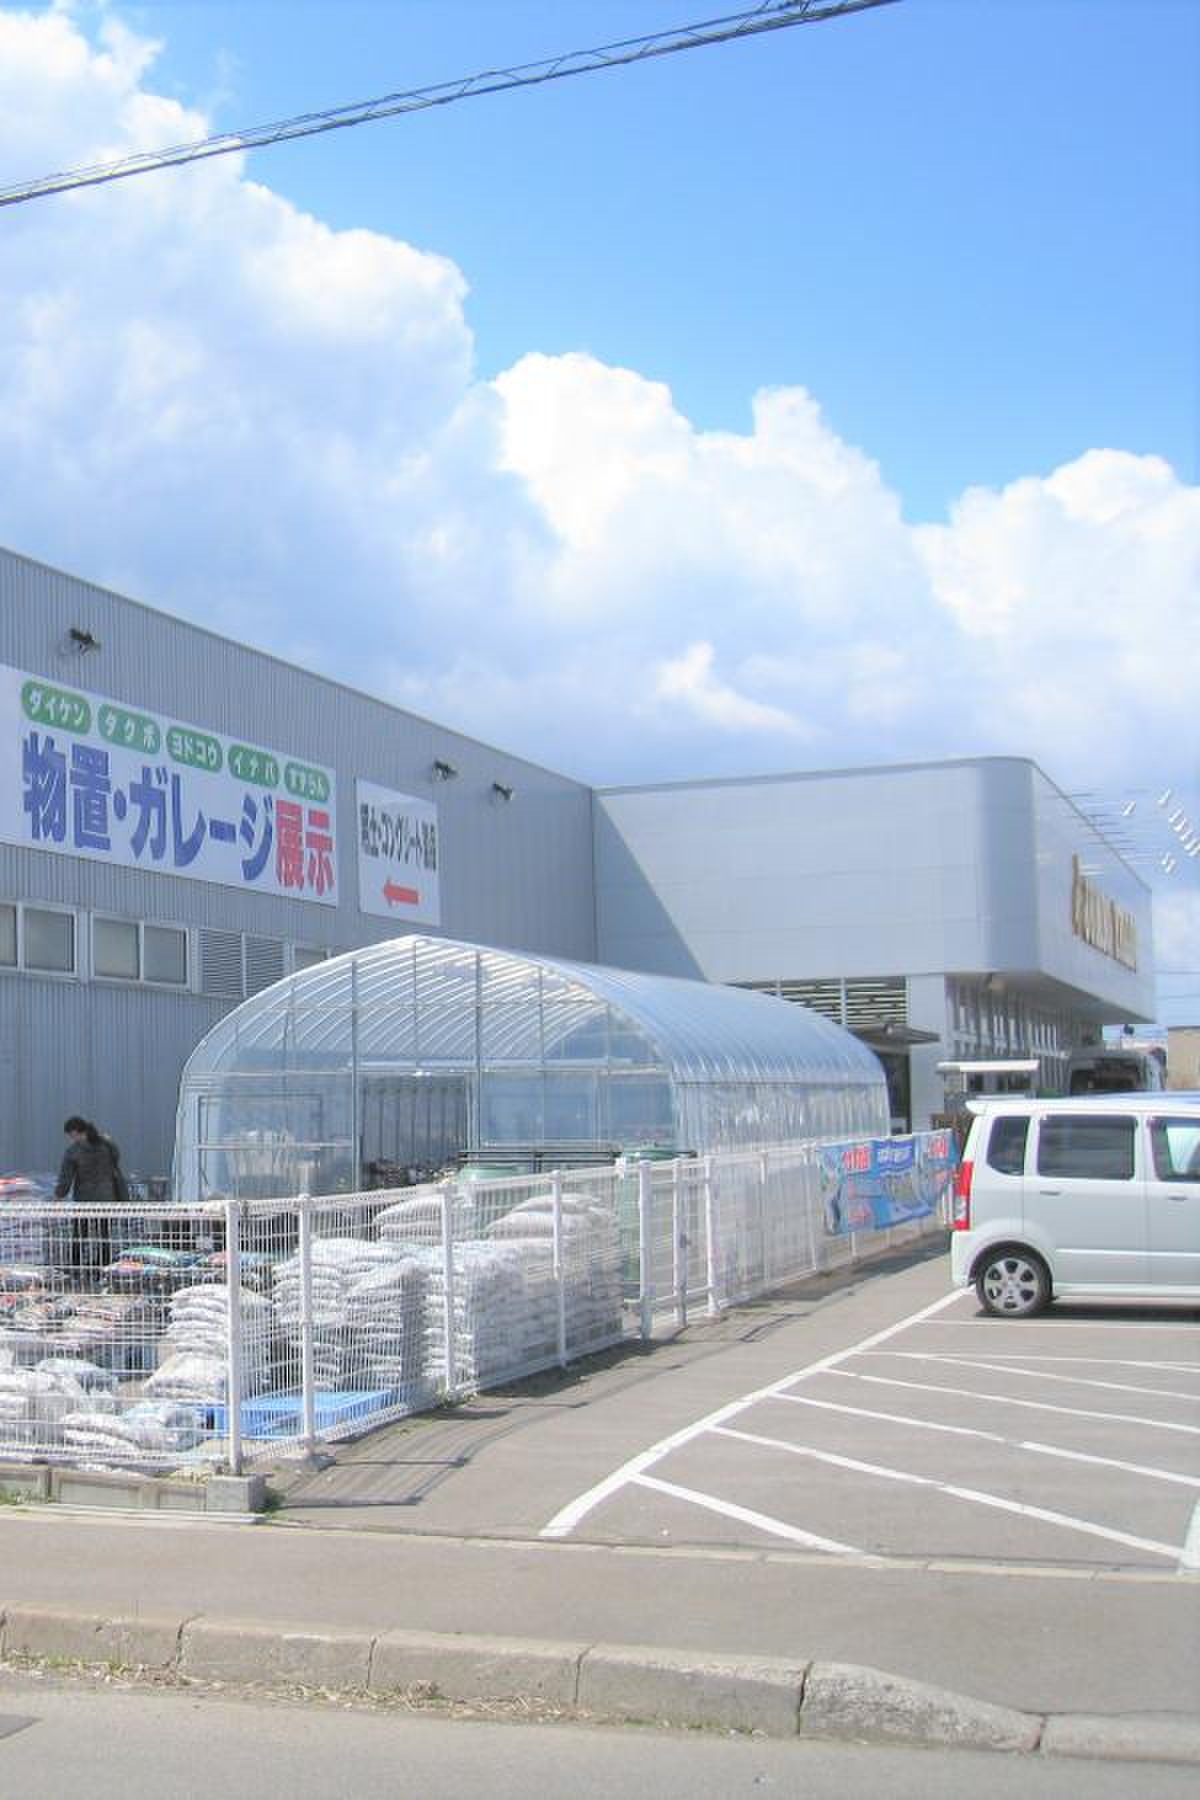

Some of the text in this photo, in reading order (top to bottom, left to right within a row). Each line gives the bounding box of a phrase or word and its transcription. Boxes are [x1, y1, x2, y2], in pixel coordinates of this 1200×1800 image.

[29, 688, 86, 726] ダイケン
[23, 730, 334, 897] 物置・ガレージ展示
